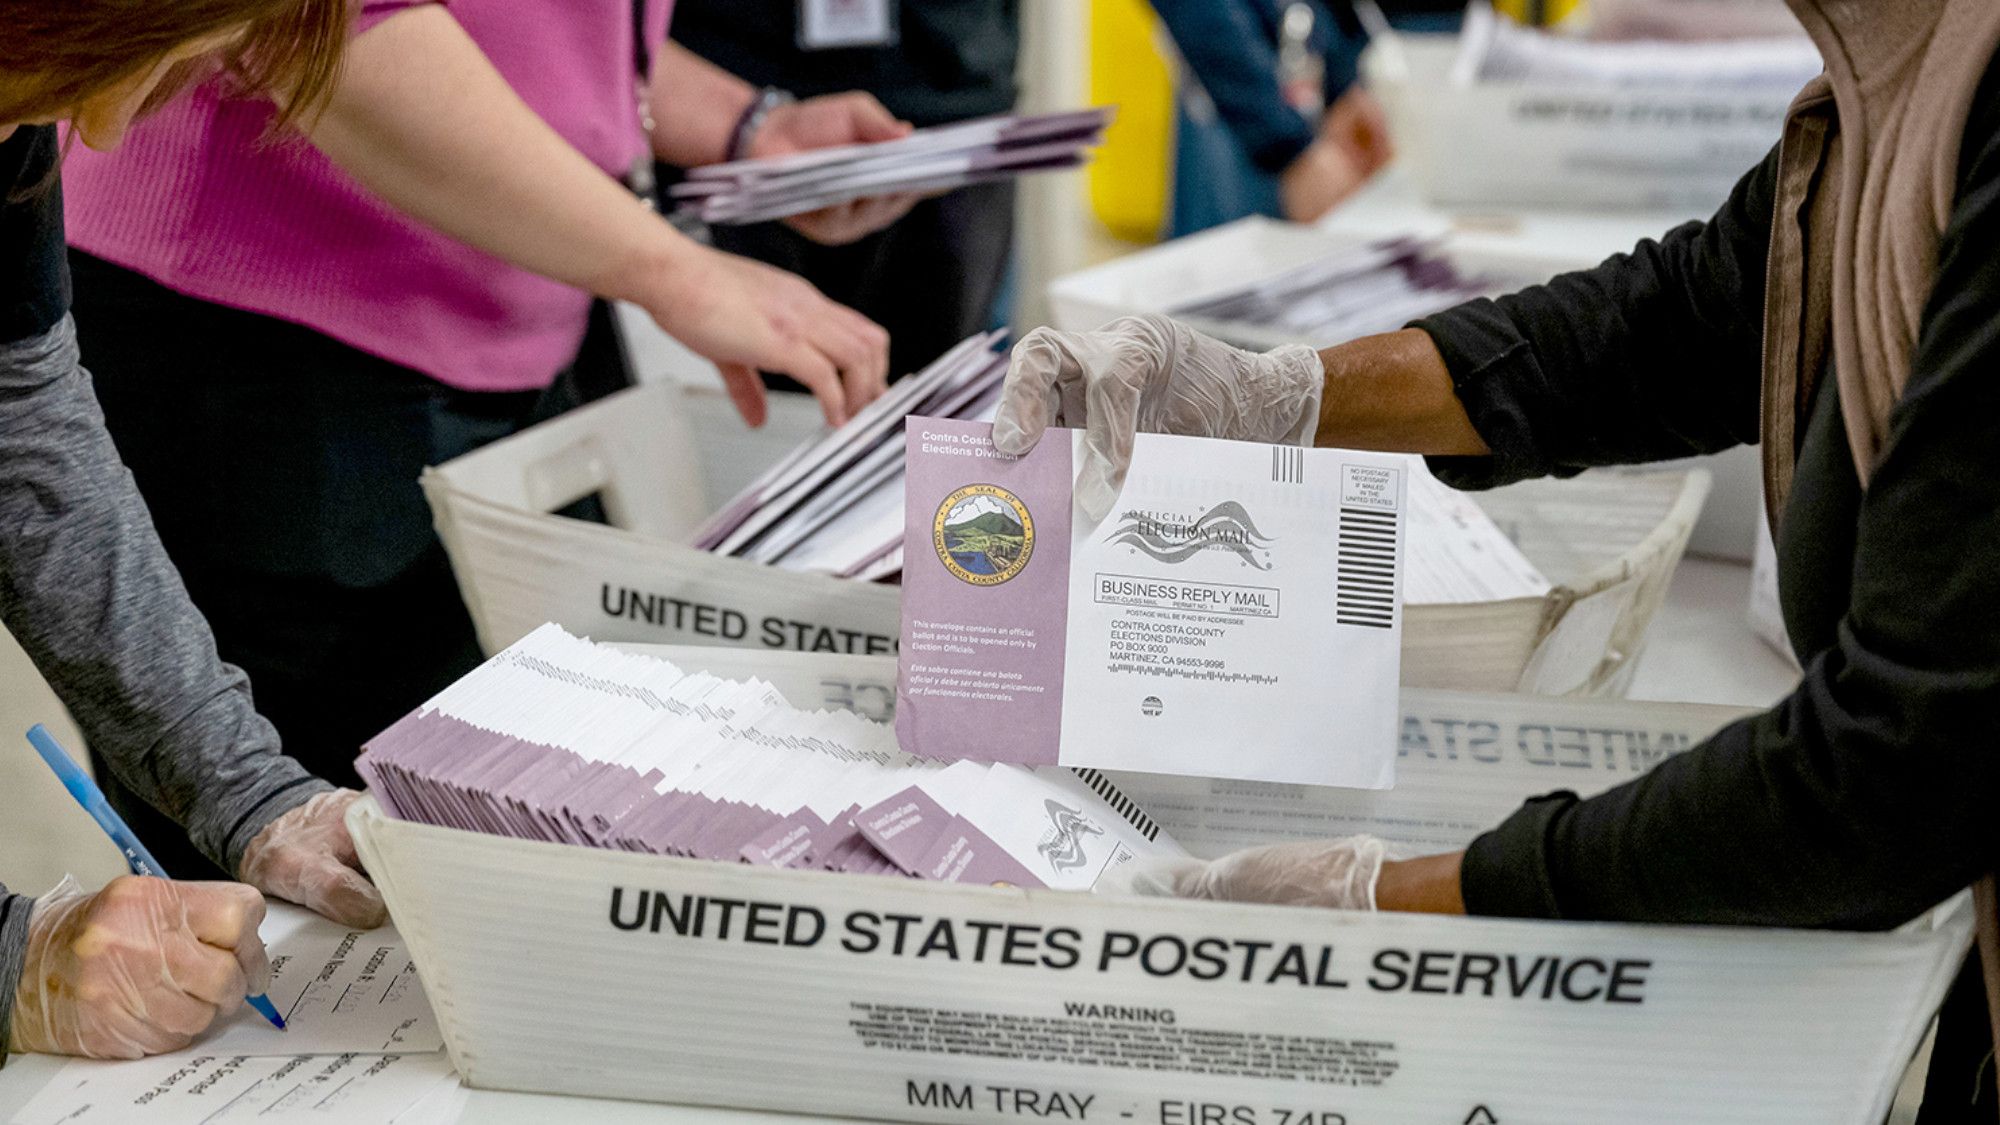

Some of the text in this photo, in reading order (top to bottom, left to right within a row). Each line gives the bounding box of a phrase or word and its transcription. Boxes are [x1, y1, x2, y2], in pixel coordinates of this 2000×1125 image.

[922, 431, 992, 446] Contra Costa
[922, 443, 972, 456] Elections
[1128, 509, 1193, 523] OFFICIAL
[1137, 519, 1251, 544] ELECTION MAIL
[1101, 580, 1270, 607] BUSINESS REPLY MAIL
[1172, 601, 1195, 609] PERMIT
[601, 582, 900, 656] UNITED STATE
[1126, 609, 1155, 618] POSTAGE
[1157, 612, 1170, 620] WILL
[1172, 613, 1180, 621] BE
[1182, 614, 1196, 622] PAID
[1197, 615, 1206, 623] BY
[913, 620, 928, 628] This
[930, 622, 964, 632] envelope
[966, 625, 996, 634] contains
[1009, 628, 1034, 637] official
[1111, 619, 1225, 638] CONTRA COSTA COUNTY
[912, 631, 934, 640] ballot
[936, 633, 951, 641] and
[970, 635, 979, 644] be
[981, 637, 1008, 647] opened
[1010, 639, 1025, 649] only
[1027, 640, 1037, 650] by
[1110, 630, 1206, 647] ELECTIONS DIVISION
[912, 642, 942, 651] Election
[1110, 641, 1168, 654] PO BOX 9000
[1110, 651, 1160, 665] MARTINEZ,
[1161, 656, 1175, 666] CA
[911, 664, 926, 673] Este
[928, 665, 948, 674] sobre
[950, 668, 981, 677] contiene
[910, 675, 934, 684] oficial
[941, 677, 959, 686] debe
[909, 687, 922, 695] por
[608, 887, 1652, 1004] UNITED STATES POSTAL SERVICE
[1063, 1002, 1176, 1025] WARNING
[906, 1080, 975, 1112] MM
[986, 1086, 1097, 1122] TRAY
[1160, 1101, 1257, 1125] EIRS
